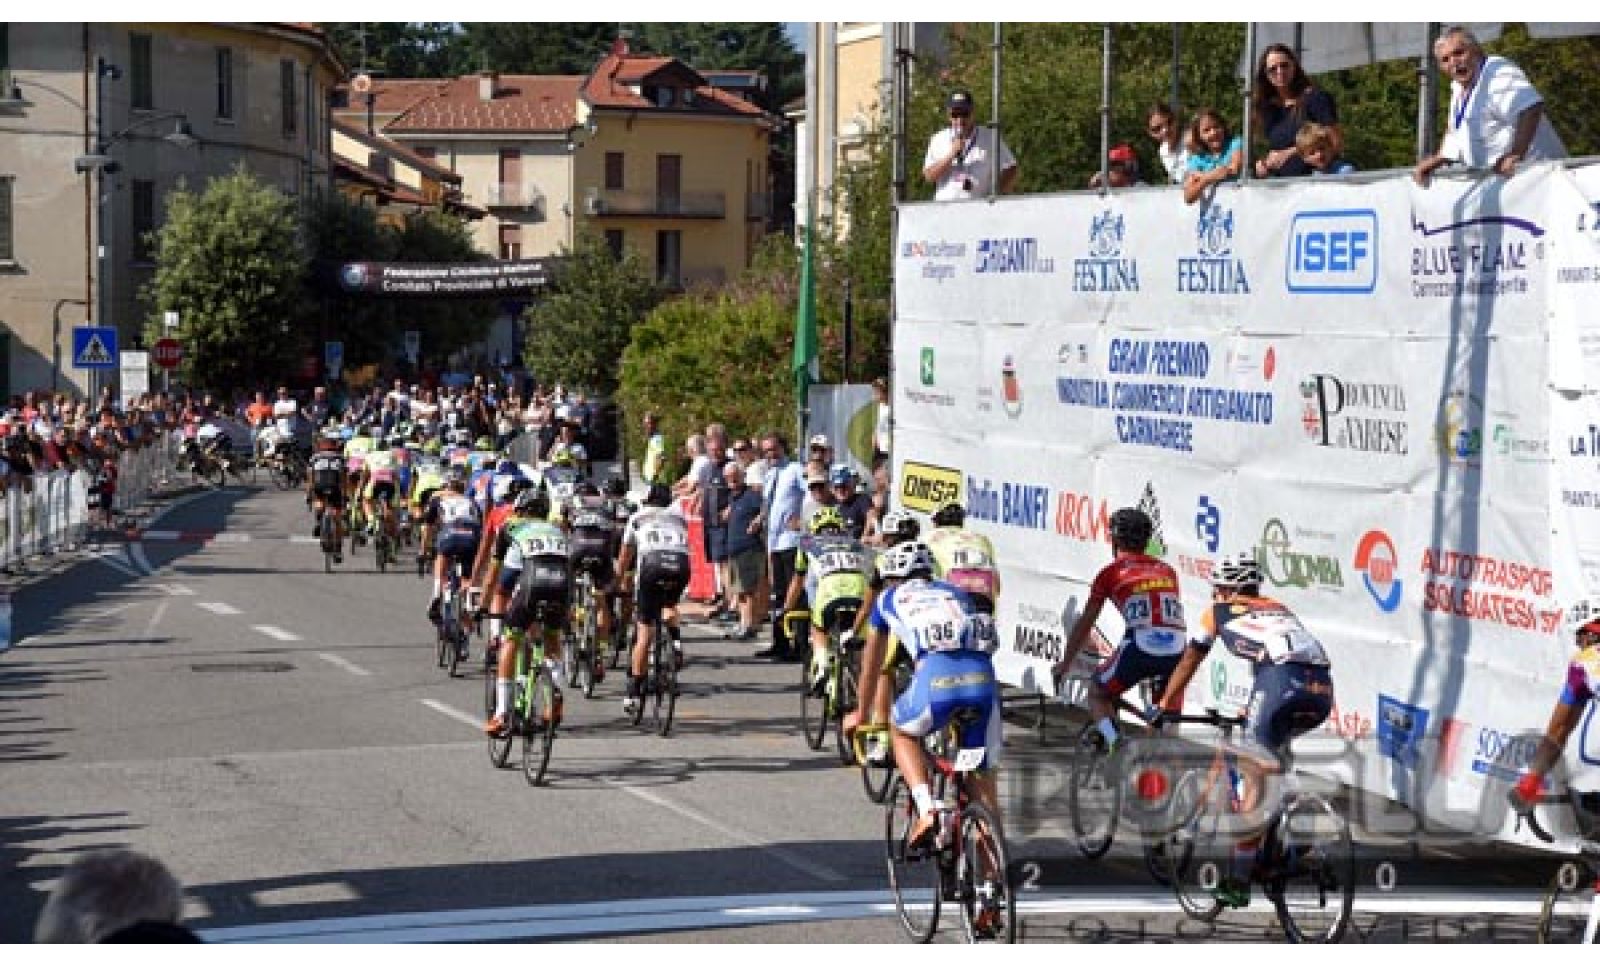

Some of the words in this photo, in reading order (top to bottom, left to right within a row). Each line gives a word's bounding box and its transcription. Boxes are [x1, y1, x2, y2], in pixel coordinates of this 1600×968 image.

[1295, 232, 1369, 271] ISEF
[1411, 246, 1463, 275] BLUE
[1109, 338, 1149, 374] GRAN
[1152, 341, 1211, 379] PREMIO
[1186, 386, 1273, 424] ARTIGIANATO
[1002, 482, 1049, 529] BANFI
